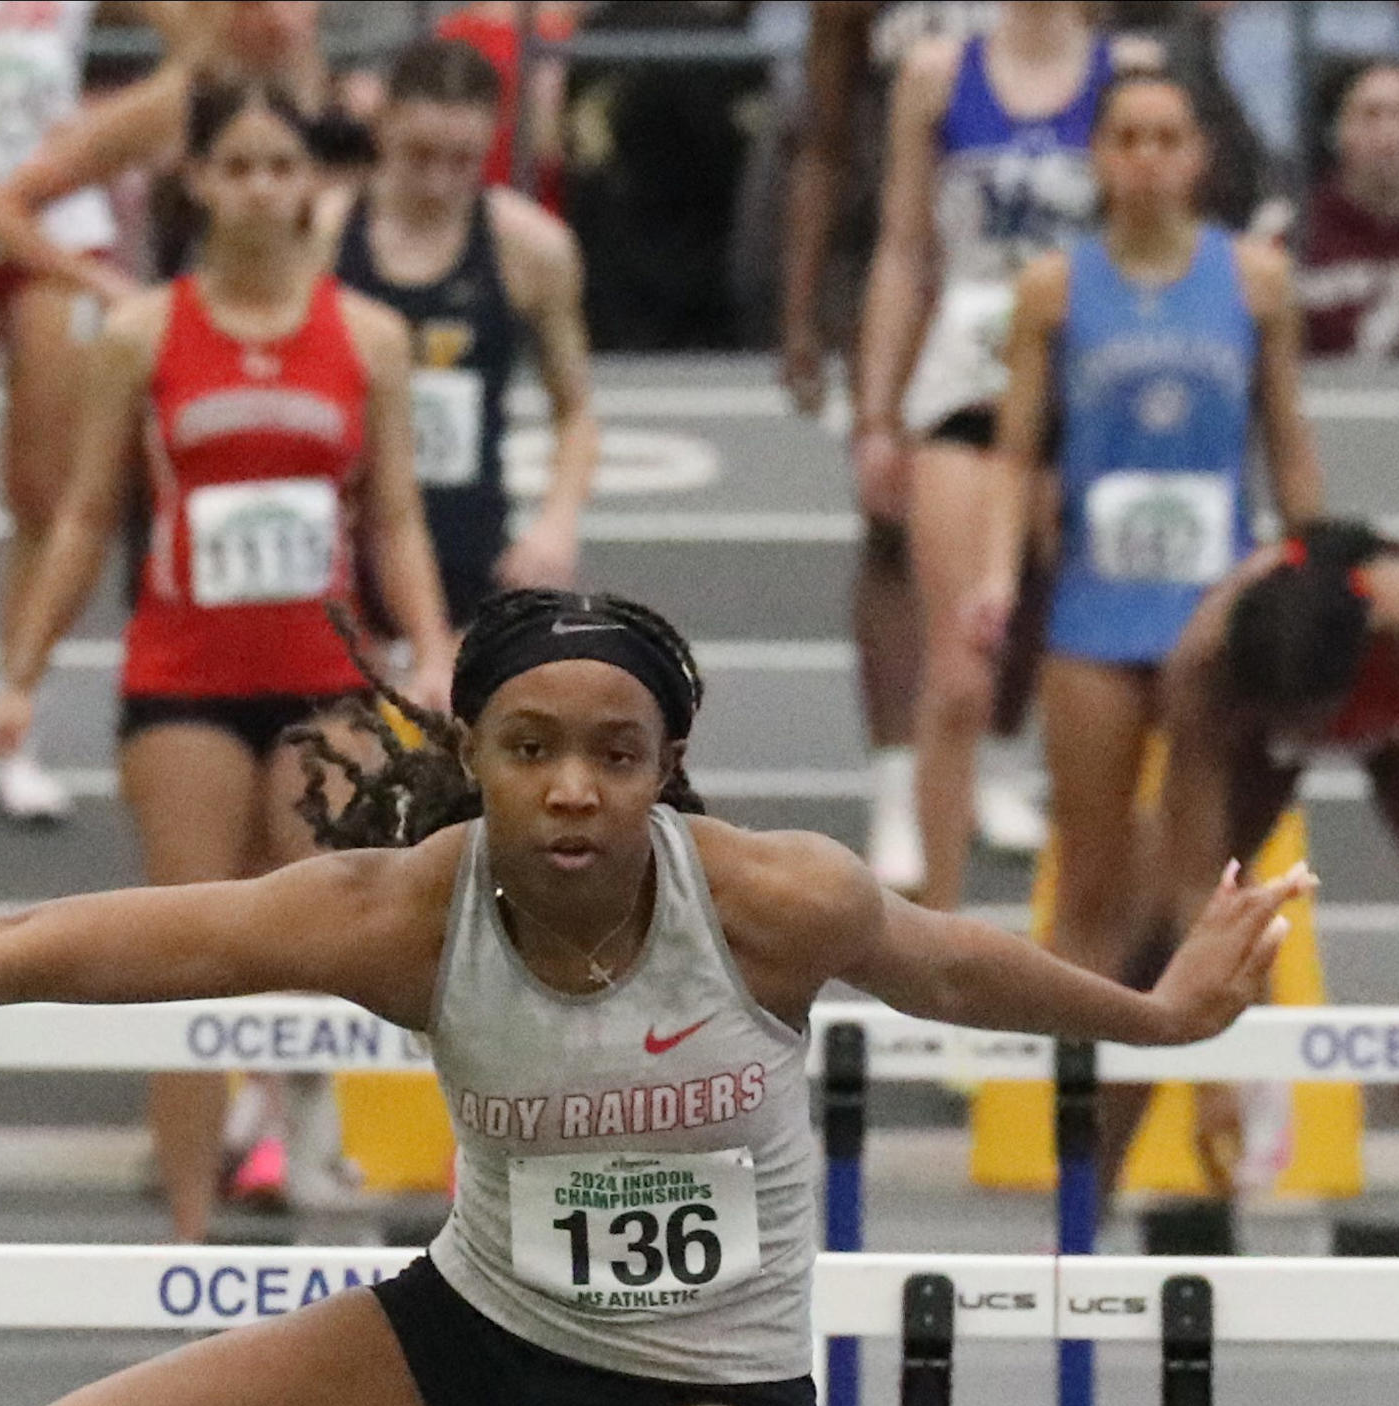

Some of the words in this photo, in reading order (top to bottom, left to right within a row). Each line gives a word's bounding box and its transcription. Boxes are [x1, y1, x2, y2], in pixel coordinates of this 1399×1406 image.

[187, 1014, 381, 1058] OCEAN
[460, 1089, 548, 1141] ADY
[560, 1061, 766, 1140] RAIDERS
[569, 1170, 618, 1192] 2024
[622, 1170, 696, 1190] INDOOR
[554, 1184, 712, 1210] CHAMPIONSHIPS
[553, 1203, 722, 1287] 136
[957, 1291, 1037, 1310] UCS
[1069, 1295, 1148, 1315] UCS
